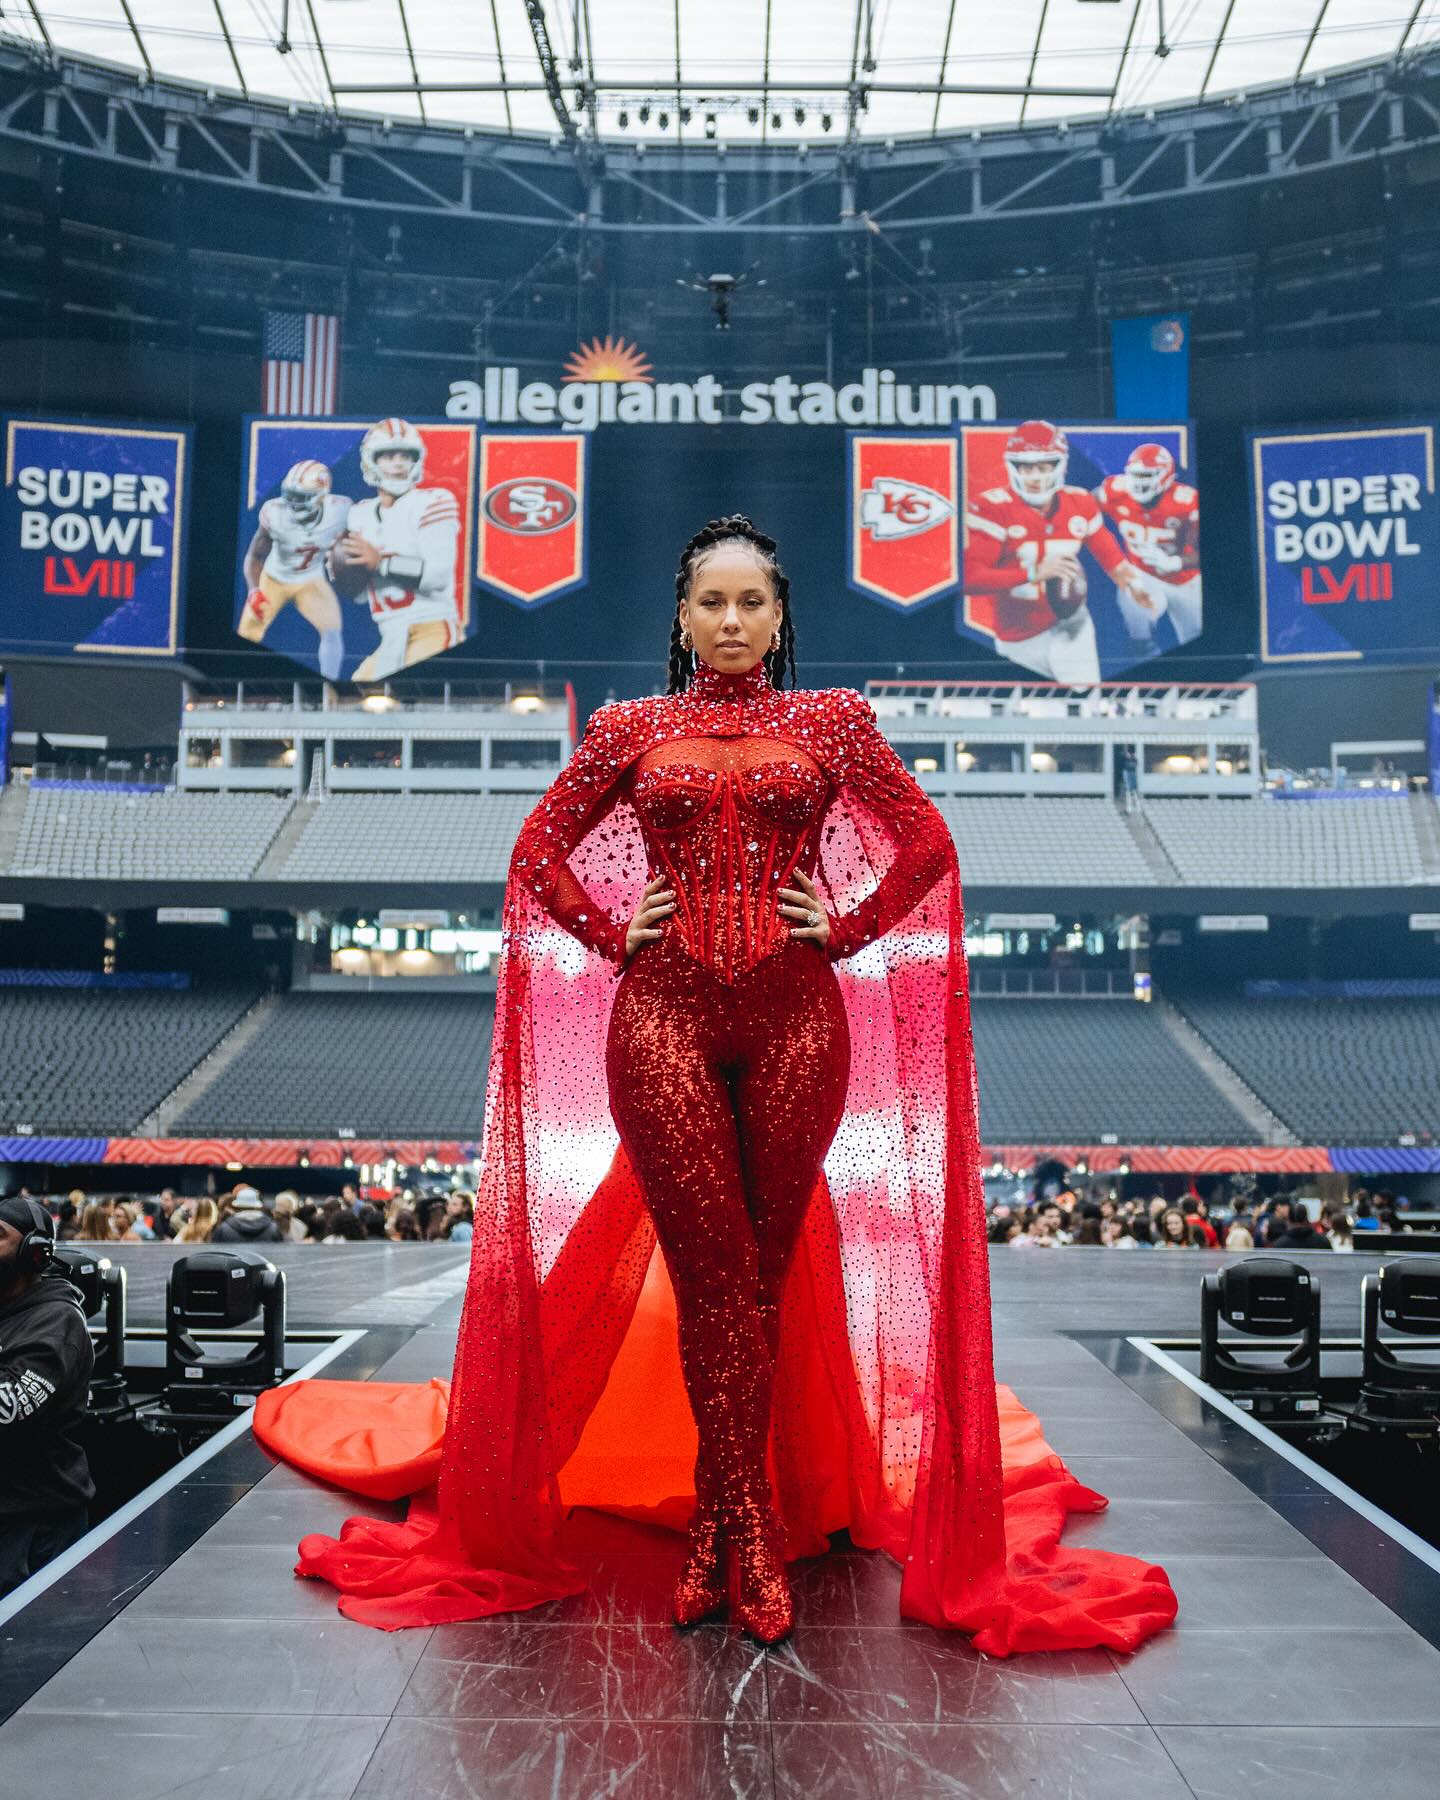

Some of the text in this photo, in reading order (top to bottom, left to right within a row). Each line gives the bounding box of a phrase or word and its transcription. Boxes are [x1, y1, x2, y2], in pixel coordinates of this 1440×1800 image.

[446, 367, 997, 430] allegiant stadium
[18, 467, 169, 513] SUPER
[1268, 473, 1421, 519] SUPER
[20, 511, 165, 557] BOWL
[1275, 517, 1421, 562] BOWL
[44, 556, 135, 598] LVIII
[1302, 563, 1393, 604] LVIII
